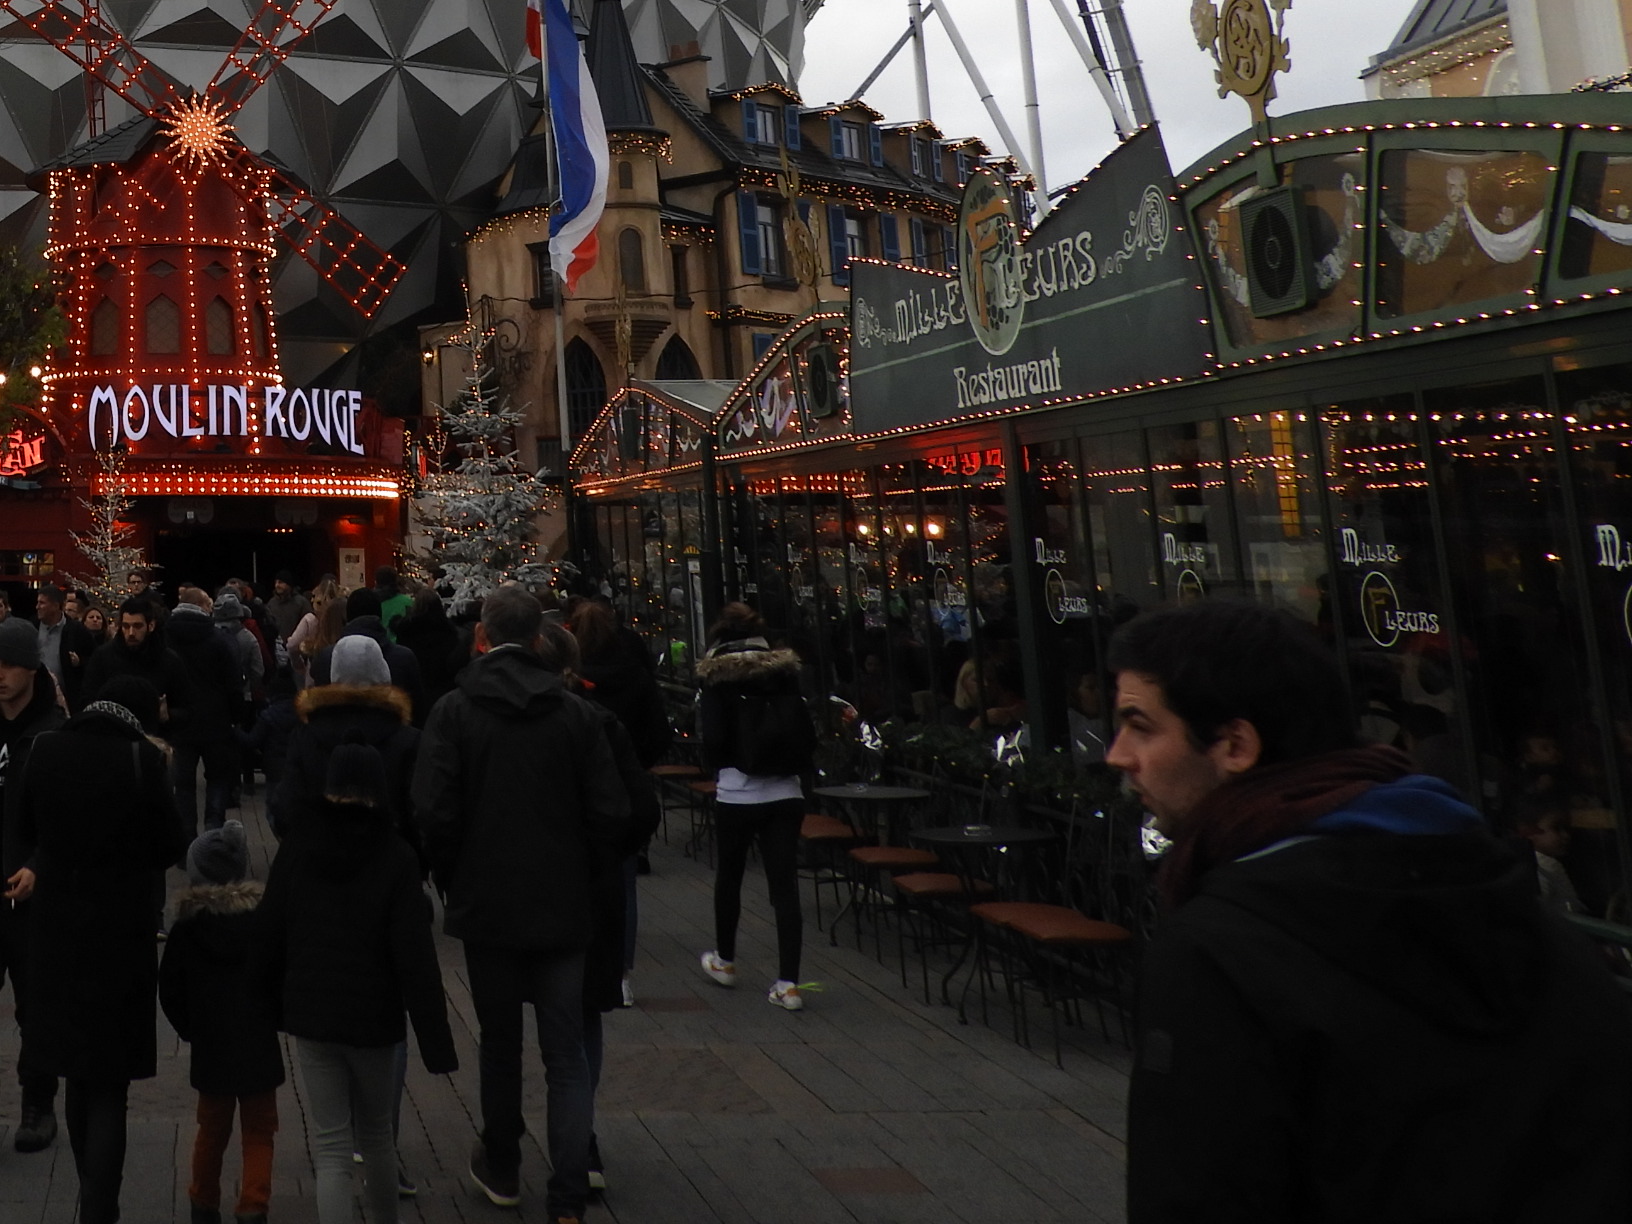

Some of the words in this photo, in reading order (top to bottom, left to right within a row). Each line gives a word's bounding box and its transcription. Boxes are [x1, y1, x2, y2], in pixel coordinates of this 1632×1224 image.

[953, 346, 1062, 408] Restaurant
[88, 383, 248, 451] MOULIN
[264, 386, 365, 456] ROUGE
